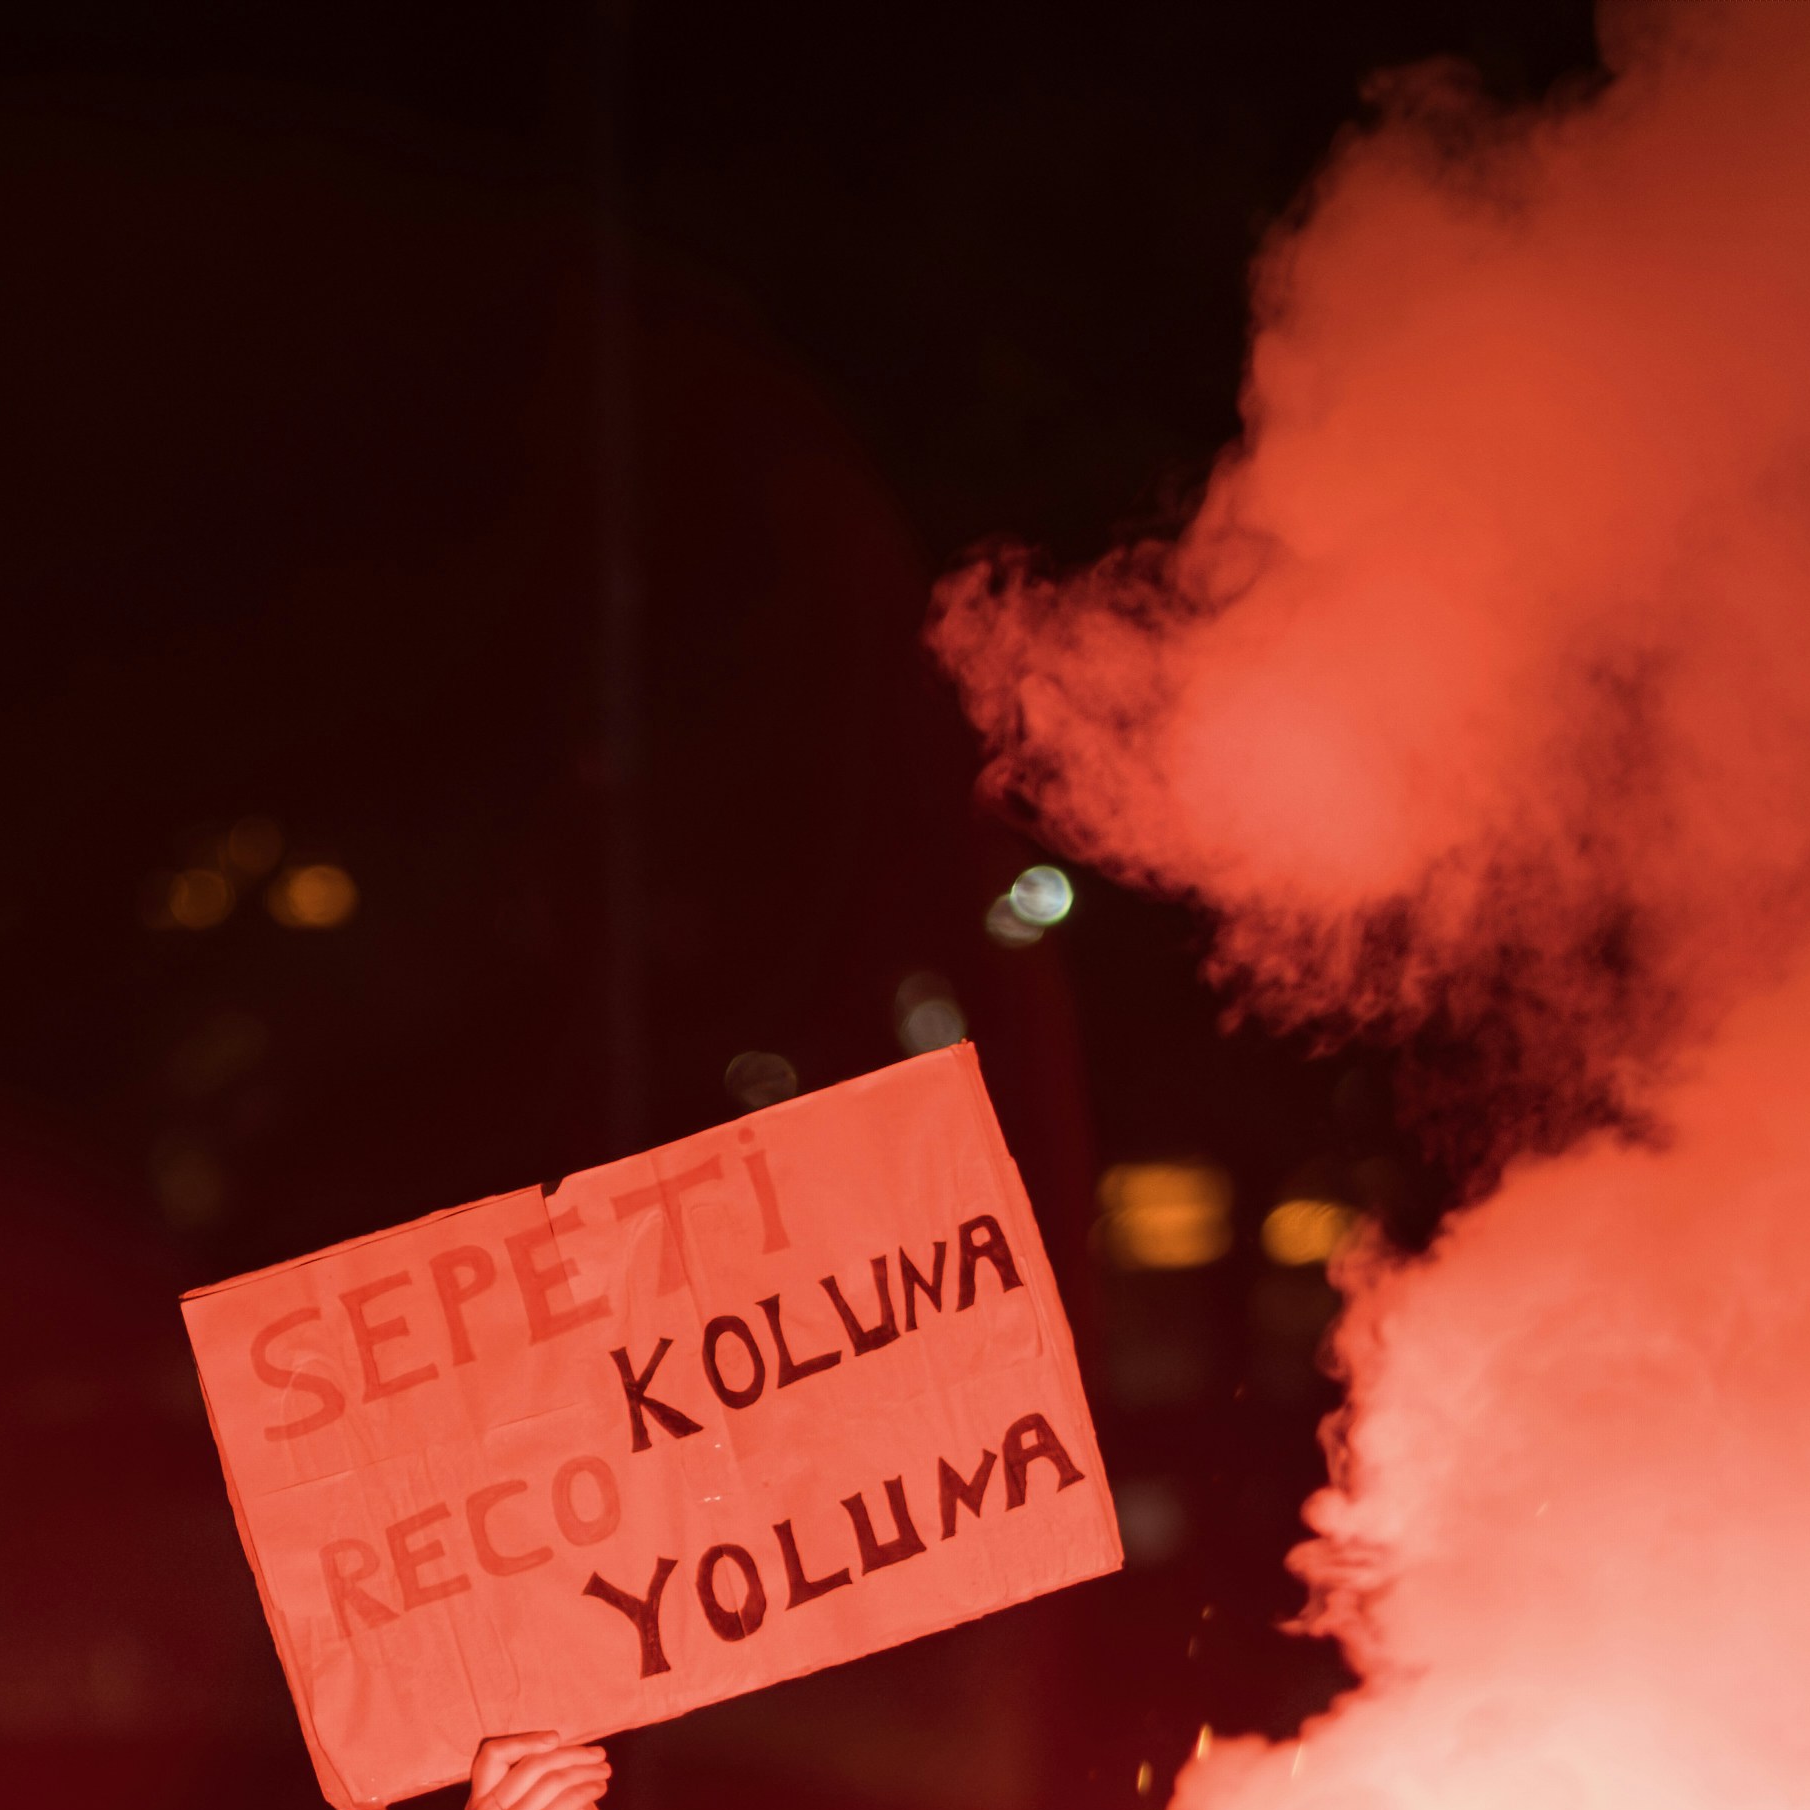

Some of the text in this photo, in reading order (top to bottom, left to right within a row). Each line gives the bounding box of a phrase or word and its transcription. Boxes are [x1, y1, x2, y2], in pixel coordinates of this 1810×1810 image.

[609, 1214, 1025, 1453] KOLUNA
[319, 1454, 622, 1638] RECO
[581, 1412, 1086, 1680] YOLUNA
